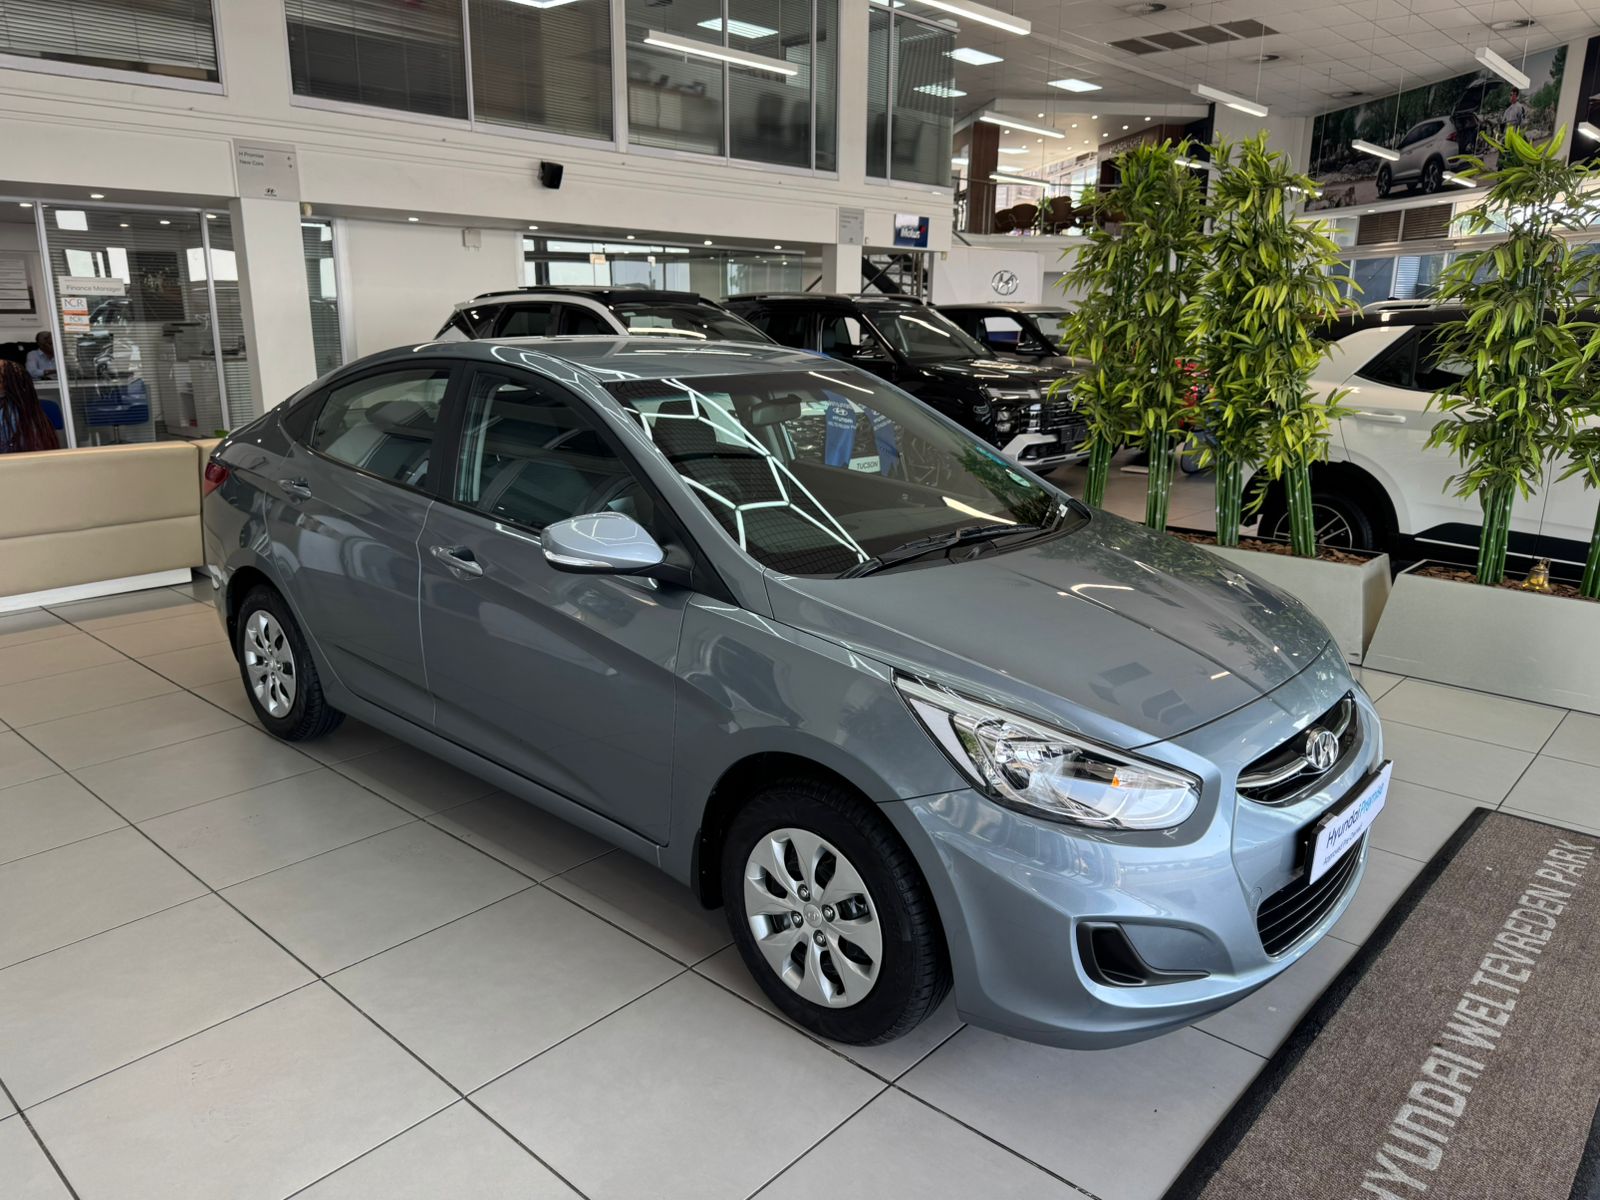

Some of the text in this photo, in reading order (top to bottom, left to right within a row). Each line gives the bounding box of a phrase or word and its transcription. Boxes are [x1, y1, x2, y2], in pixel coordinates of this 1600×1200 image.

[66, 284, 92, 292] Finance
[64, 298, 84, 308] NCR
[856, 462, 879, 470] TUCSON
[1441, 883, 1571, 1051] WELTEVREDEN
[1535, 838, 1596, 887] PARK
